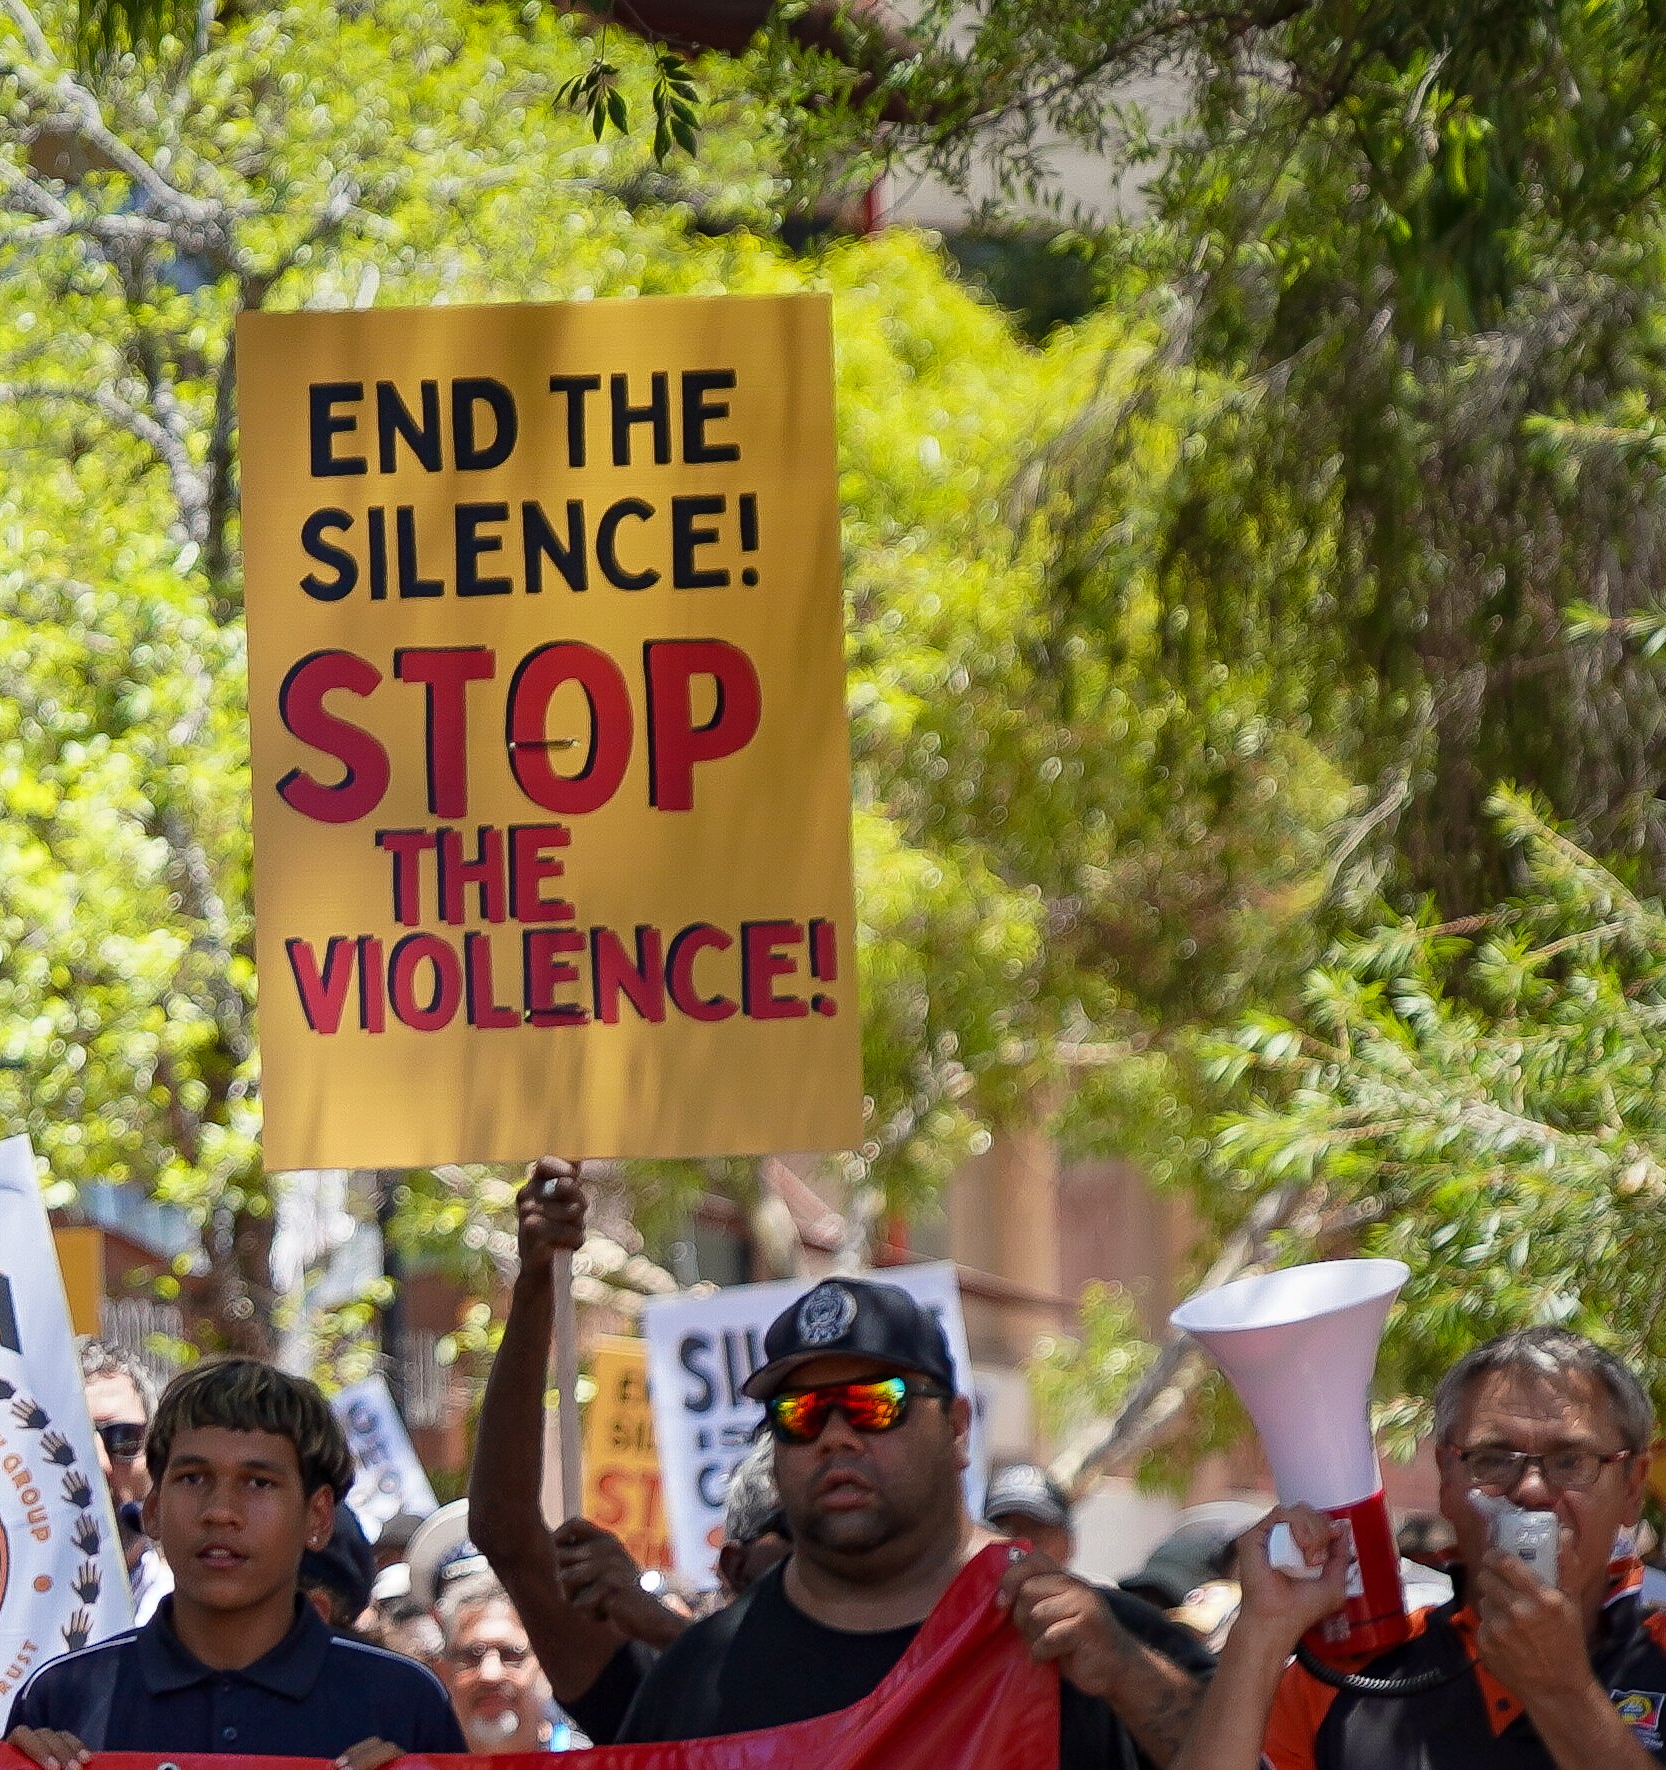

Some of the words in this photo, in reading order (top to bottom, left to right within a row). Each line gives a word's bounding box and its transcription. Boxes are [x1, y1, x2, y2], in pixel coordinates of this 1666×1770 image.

[309, 376, 518, 477] END
[548, 368, 740, 469] THE
[298, 492, 759, 602] SILENCE!
[276, 638, 763, 823] STOP
[375, 822, 576, 927] THE
[285, 917, 839, 1034] VIOLENCE!
[2, 1453, 53, 1543] GROUP
